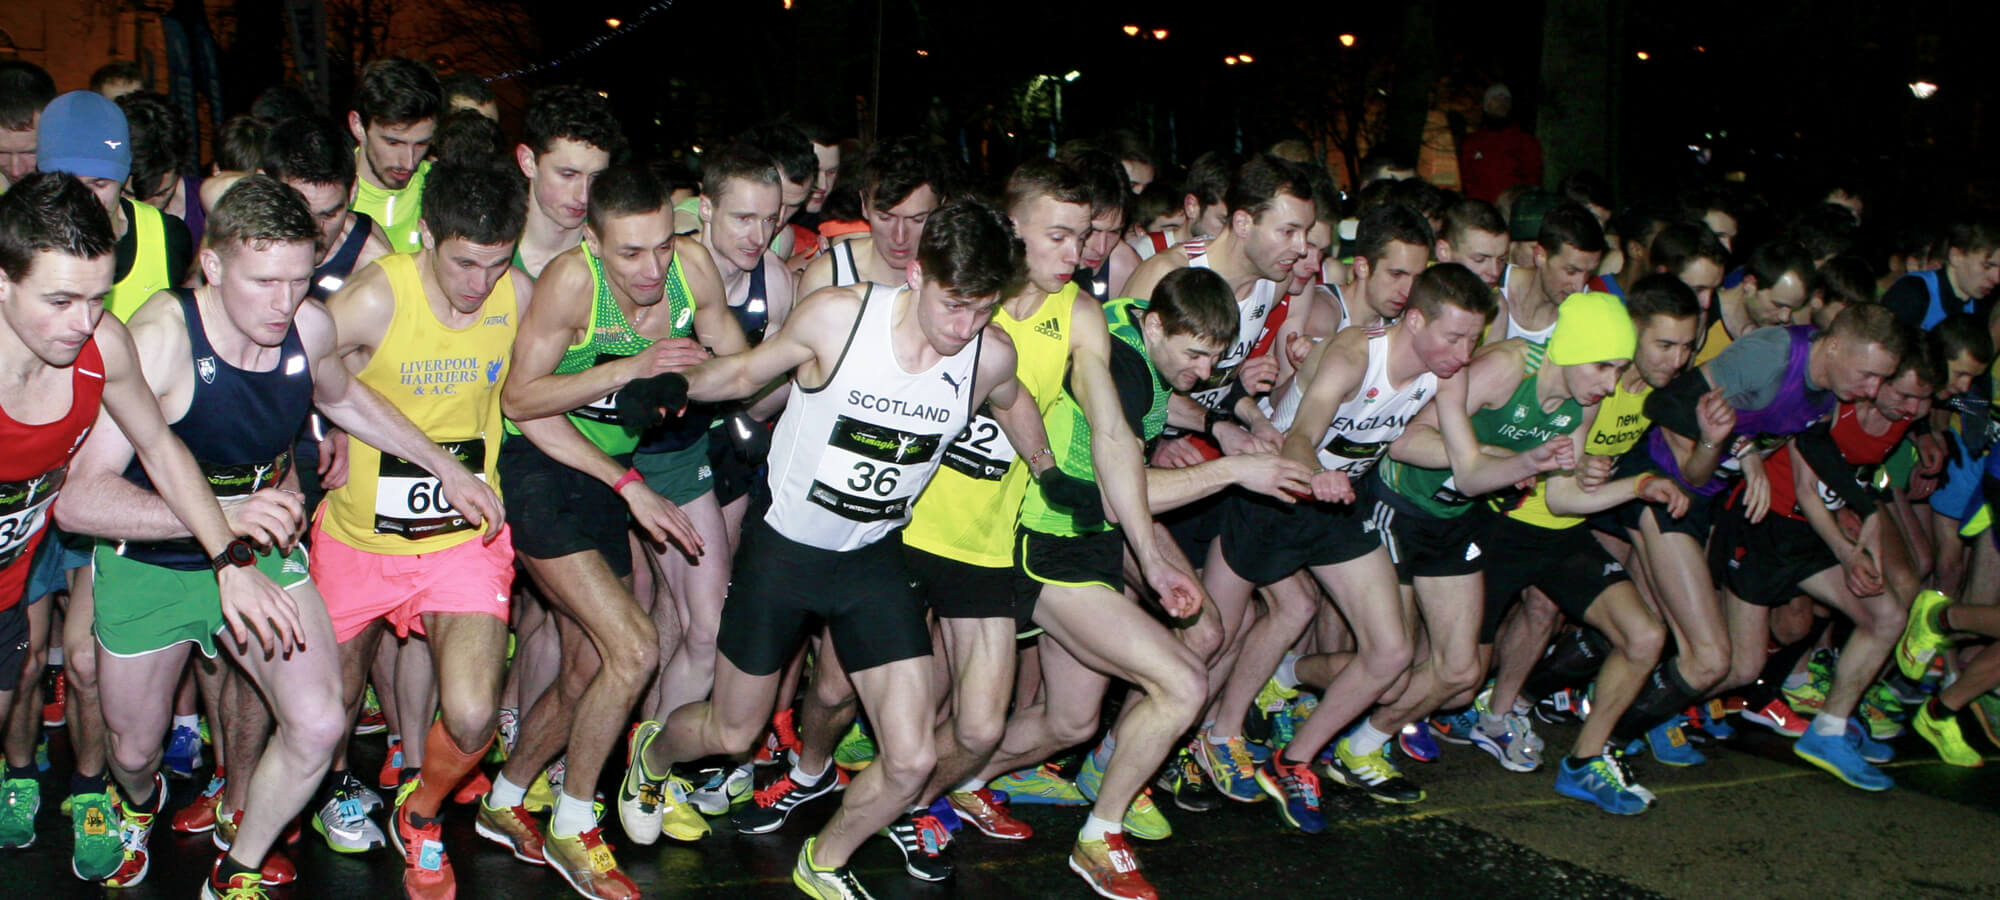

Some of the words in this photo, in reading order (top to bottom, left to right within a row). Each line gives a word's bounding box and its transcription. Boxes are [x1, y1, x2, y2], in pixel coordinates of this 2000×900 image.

[400, 357, 480, 373] LIVERPOOL
[400, 371, 478, 385] HARRIERS
[413, 386, 424, 395] &
[847, 390, 951, 424] SCOTLAND
[847, 461, 901, 497] 36
